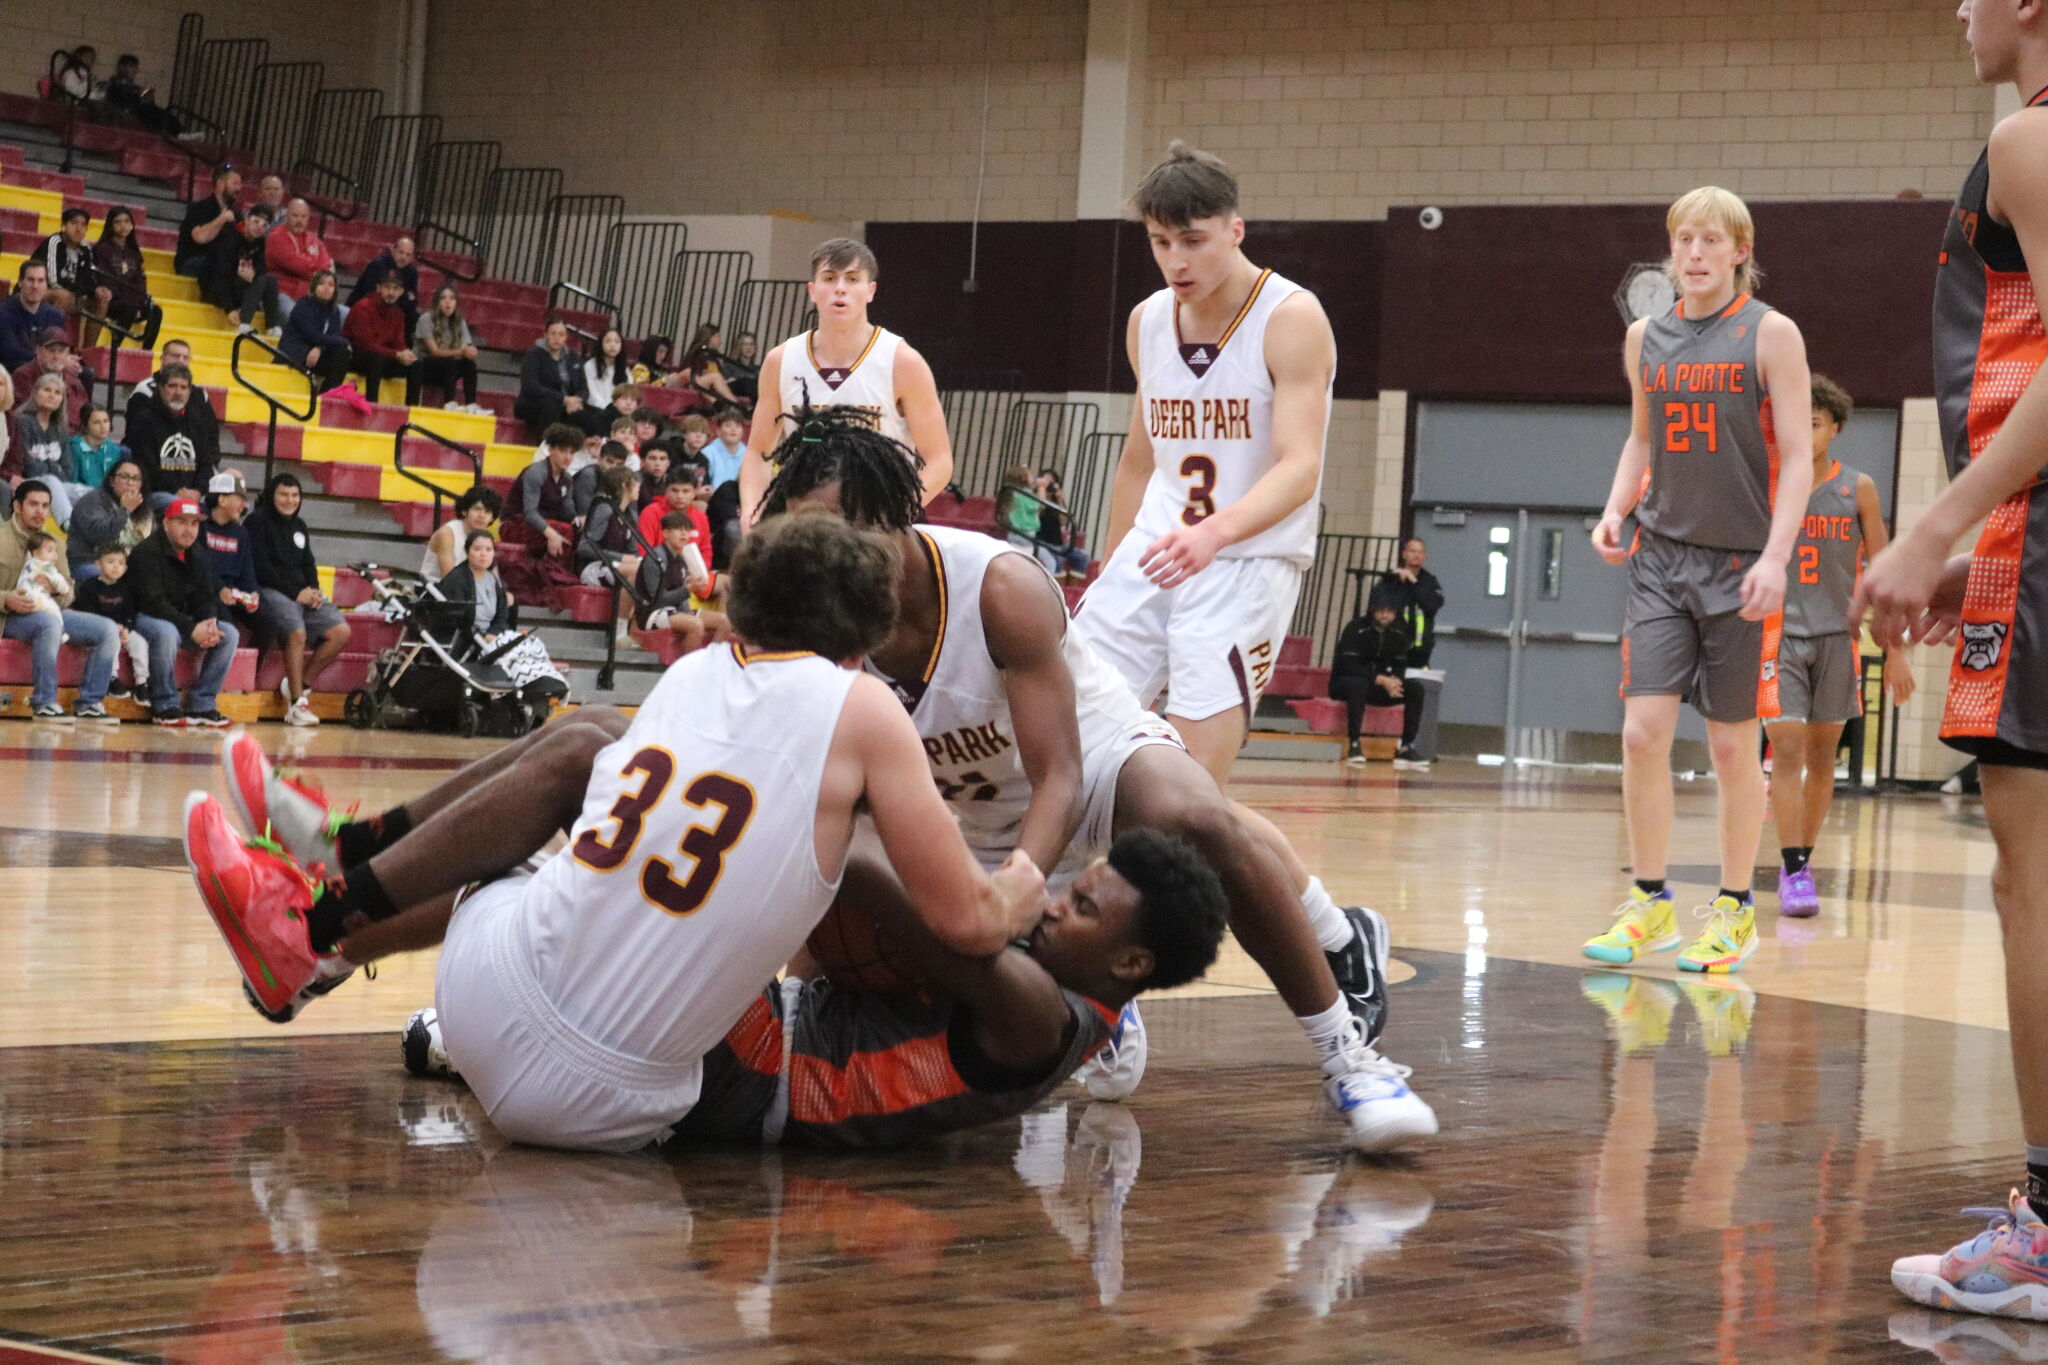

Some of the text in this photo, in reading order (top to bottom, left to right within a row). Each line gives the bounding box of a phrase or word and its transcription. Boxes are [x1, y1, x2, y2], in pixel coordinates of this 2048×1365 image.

[1642, 362, 1745, 393] LA PORTE
[1150, 397, 1252, 440] DEER PARK
[1664, 401, 1718, 453] 24
[1180, 453, 1217, 526] 3
[1798, 544, 1820, 585] 2
[923, 720, 1011, 766] PARK
[572, 744, 757, 918] 33
